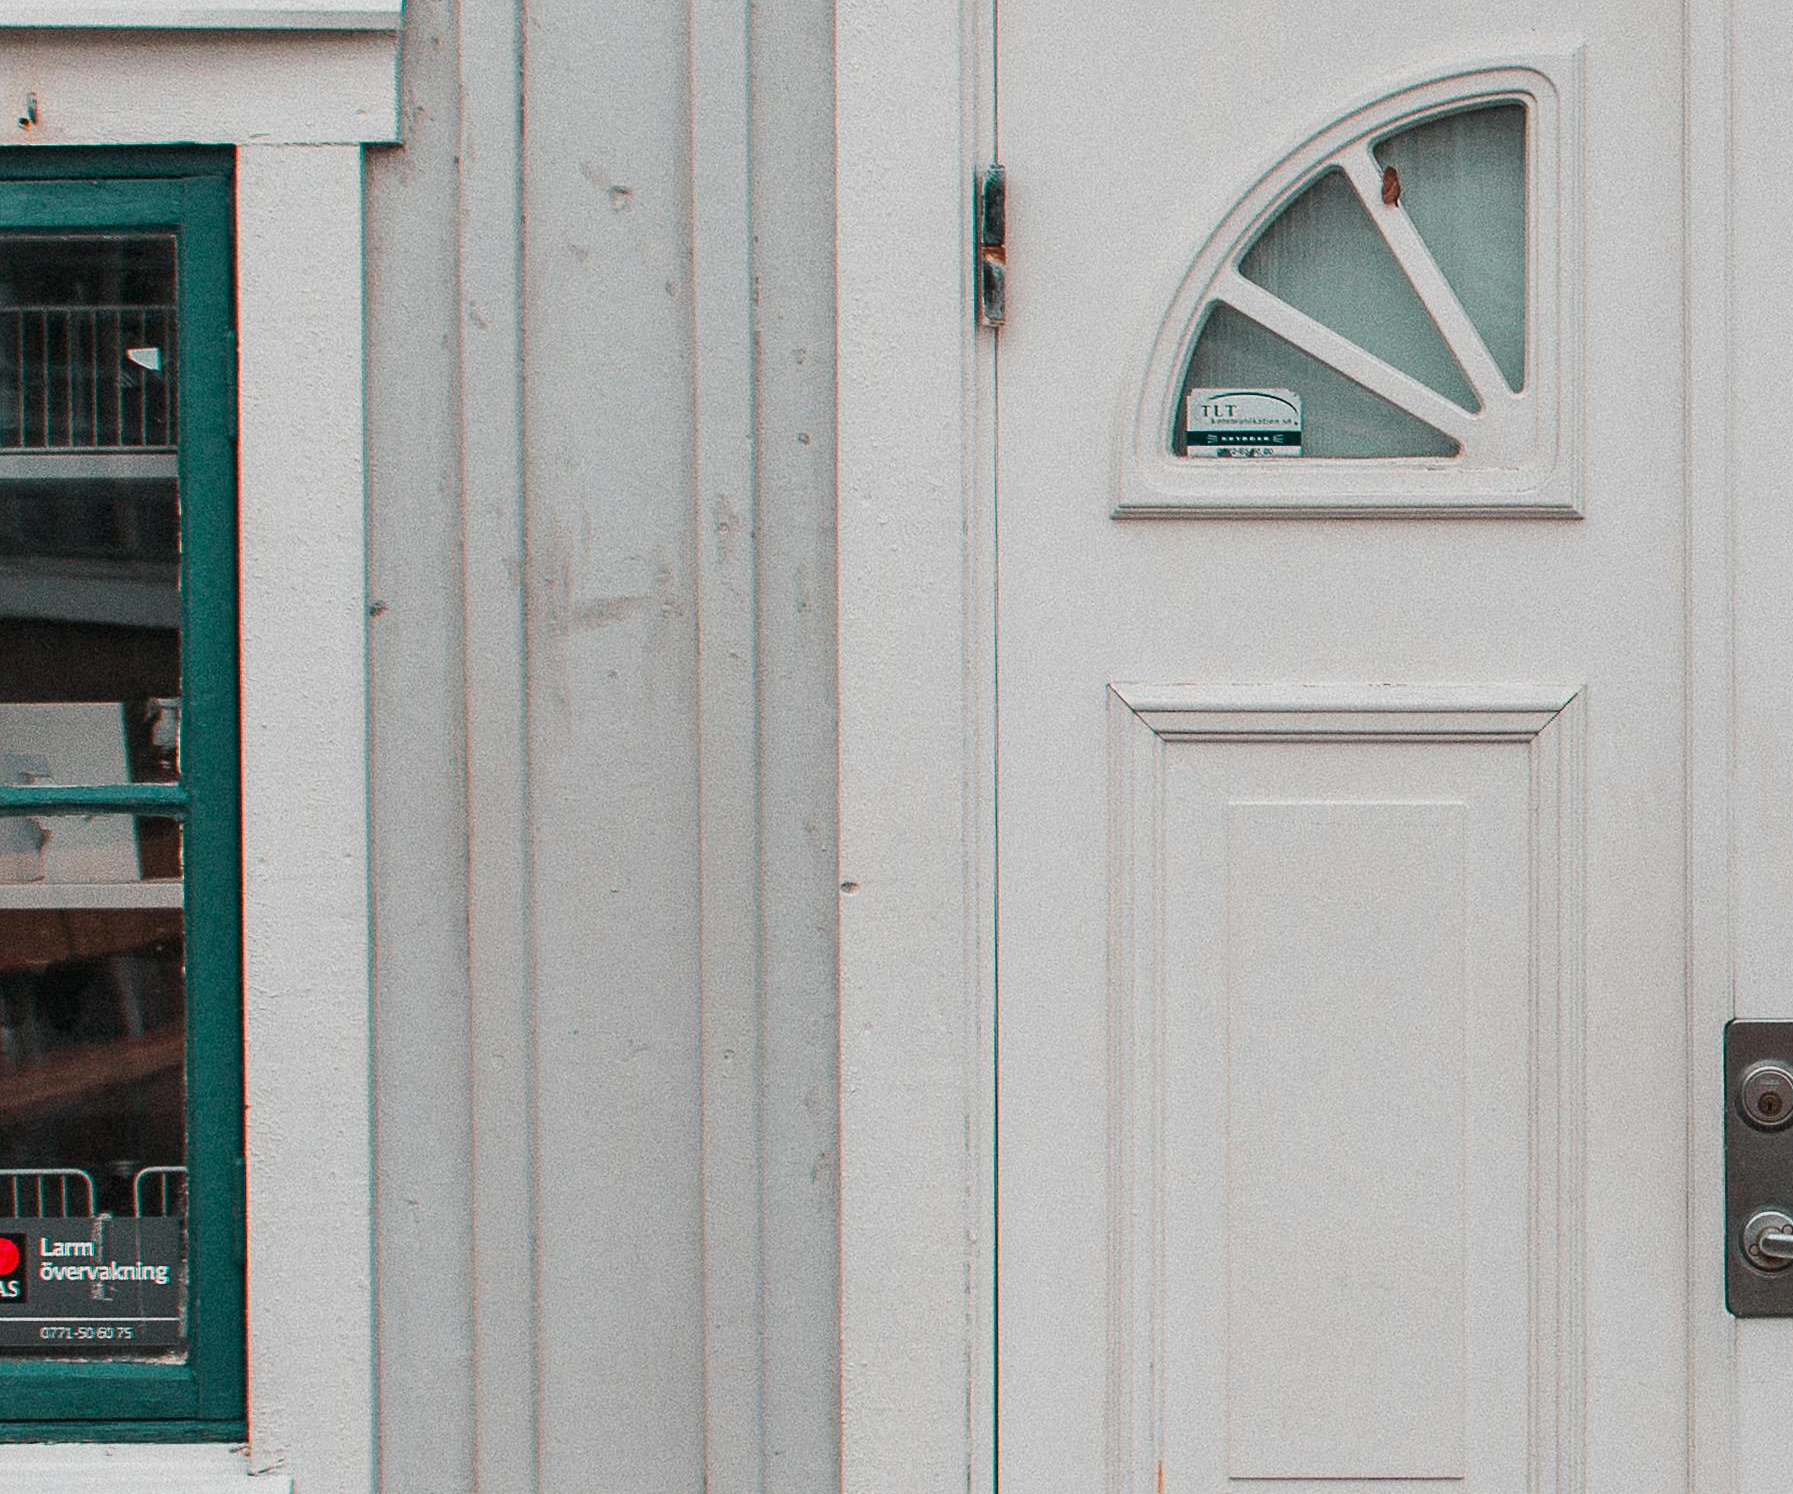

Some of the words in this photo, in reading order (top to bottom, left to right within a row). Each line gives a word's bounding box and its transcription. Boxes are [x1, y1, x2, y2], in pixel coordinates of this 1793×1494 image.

[1201, 404, 1237, 417] TLT
[40, 1237, 94, 1257] Larm
[40, 1261, 169, 1284] övervakning
